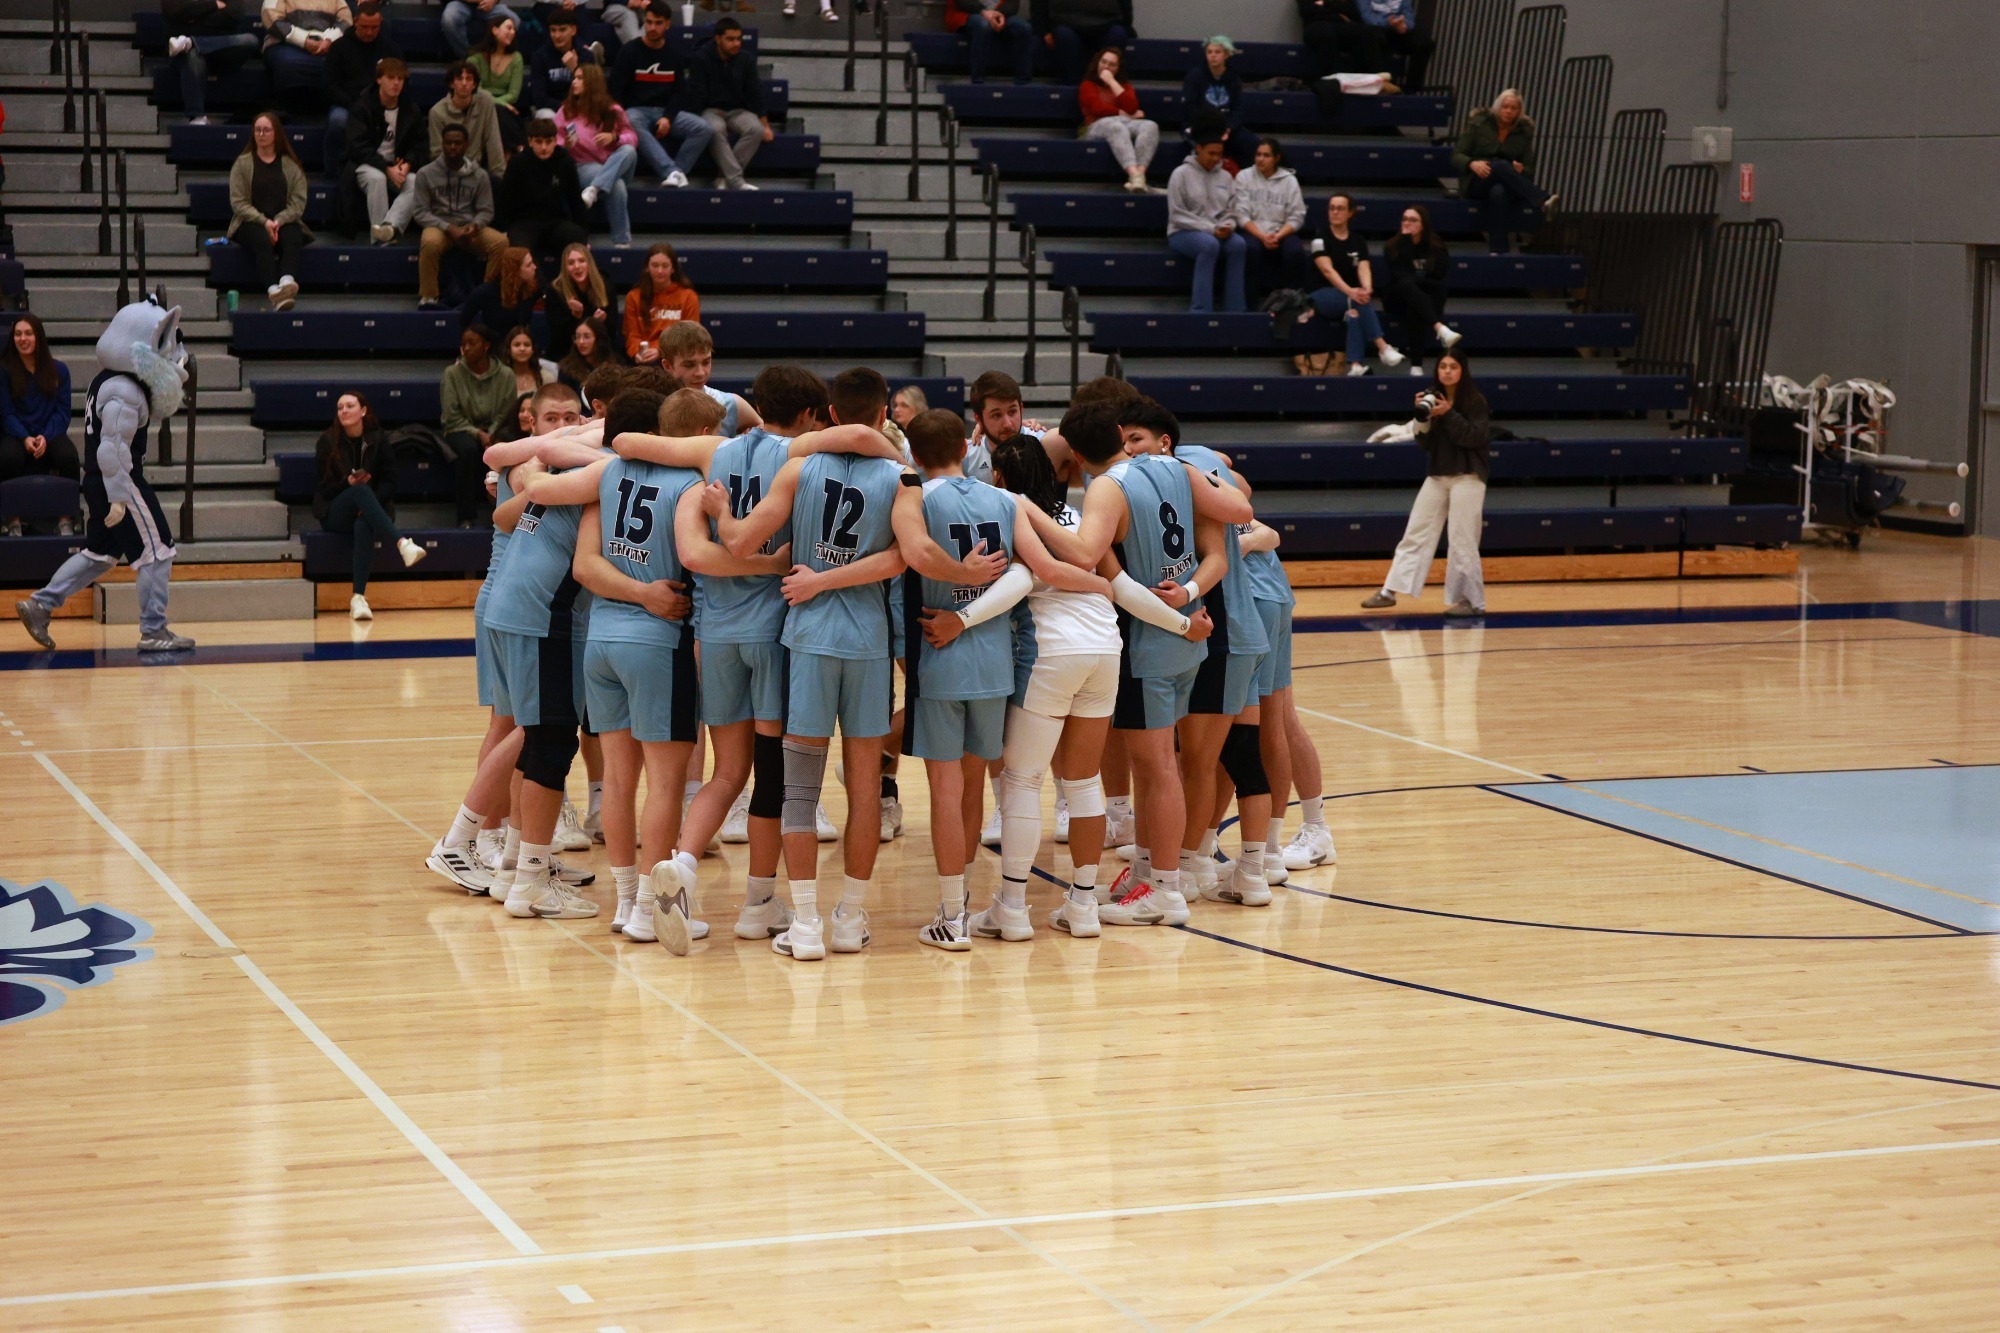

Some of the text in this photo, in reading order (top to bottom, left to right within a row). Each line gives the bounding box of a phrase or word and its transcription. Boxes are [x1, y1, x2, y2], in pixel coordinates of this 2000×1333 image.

[614, 477, 661, 545] 15
[821, 477, 866, 549] 12
[948, 521, 1001, 562] 11
[1158, 500, 1185, 560] 8
